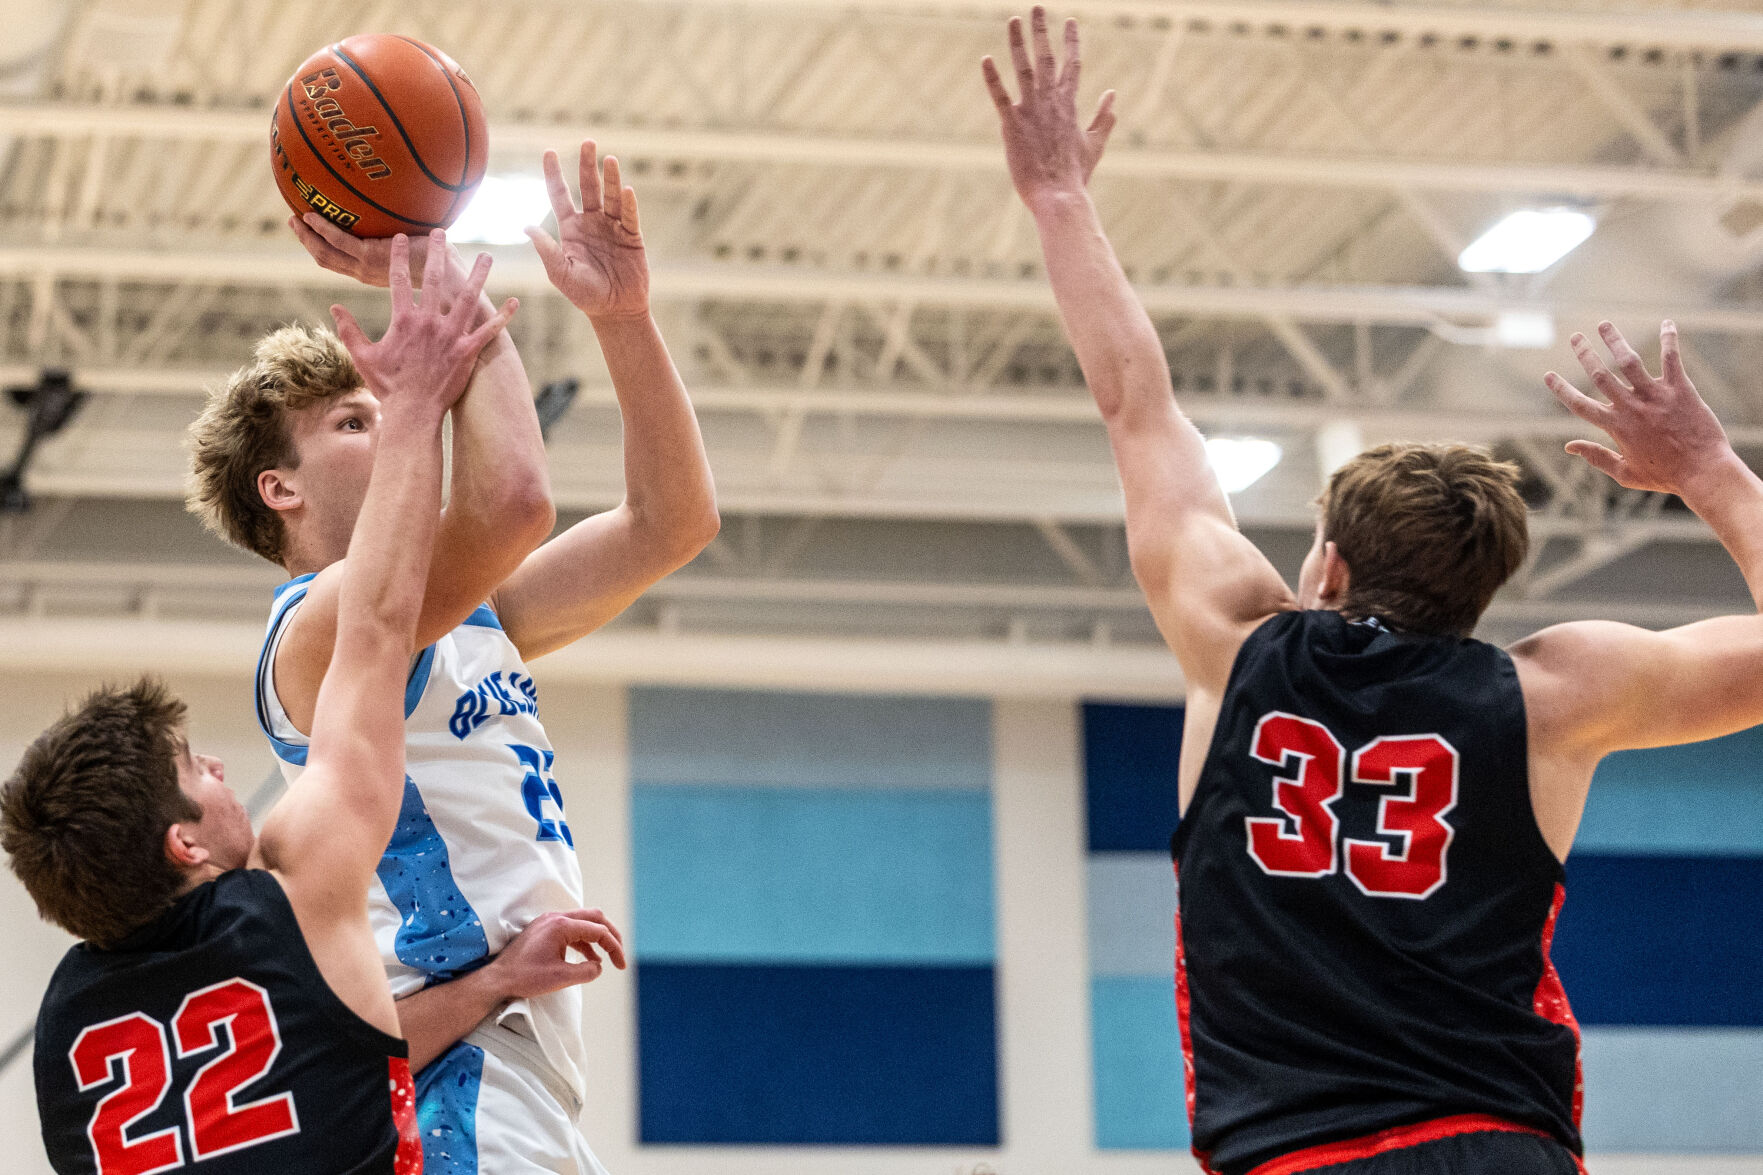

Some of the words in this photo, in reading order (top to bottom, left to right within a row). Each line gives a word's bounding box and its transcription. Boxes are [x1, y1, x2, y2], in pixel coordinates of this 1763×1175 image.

[300, 67, 393, 181] Baden
[300, 99, 352, 169] PERFECTION
[310, 193, 356, 226] PRO
[1245, 711, 1460, 900] 33
[68, 976, 300, 1175] 22
